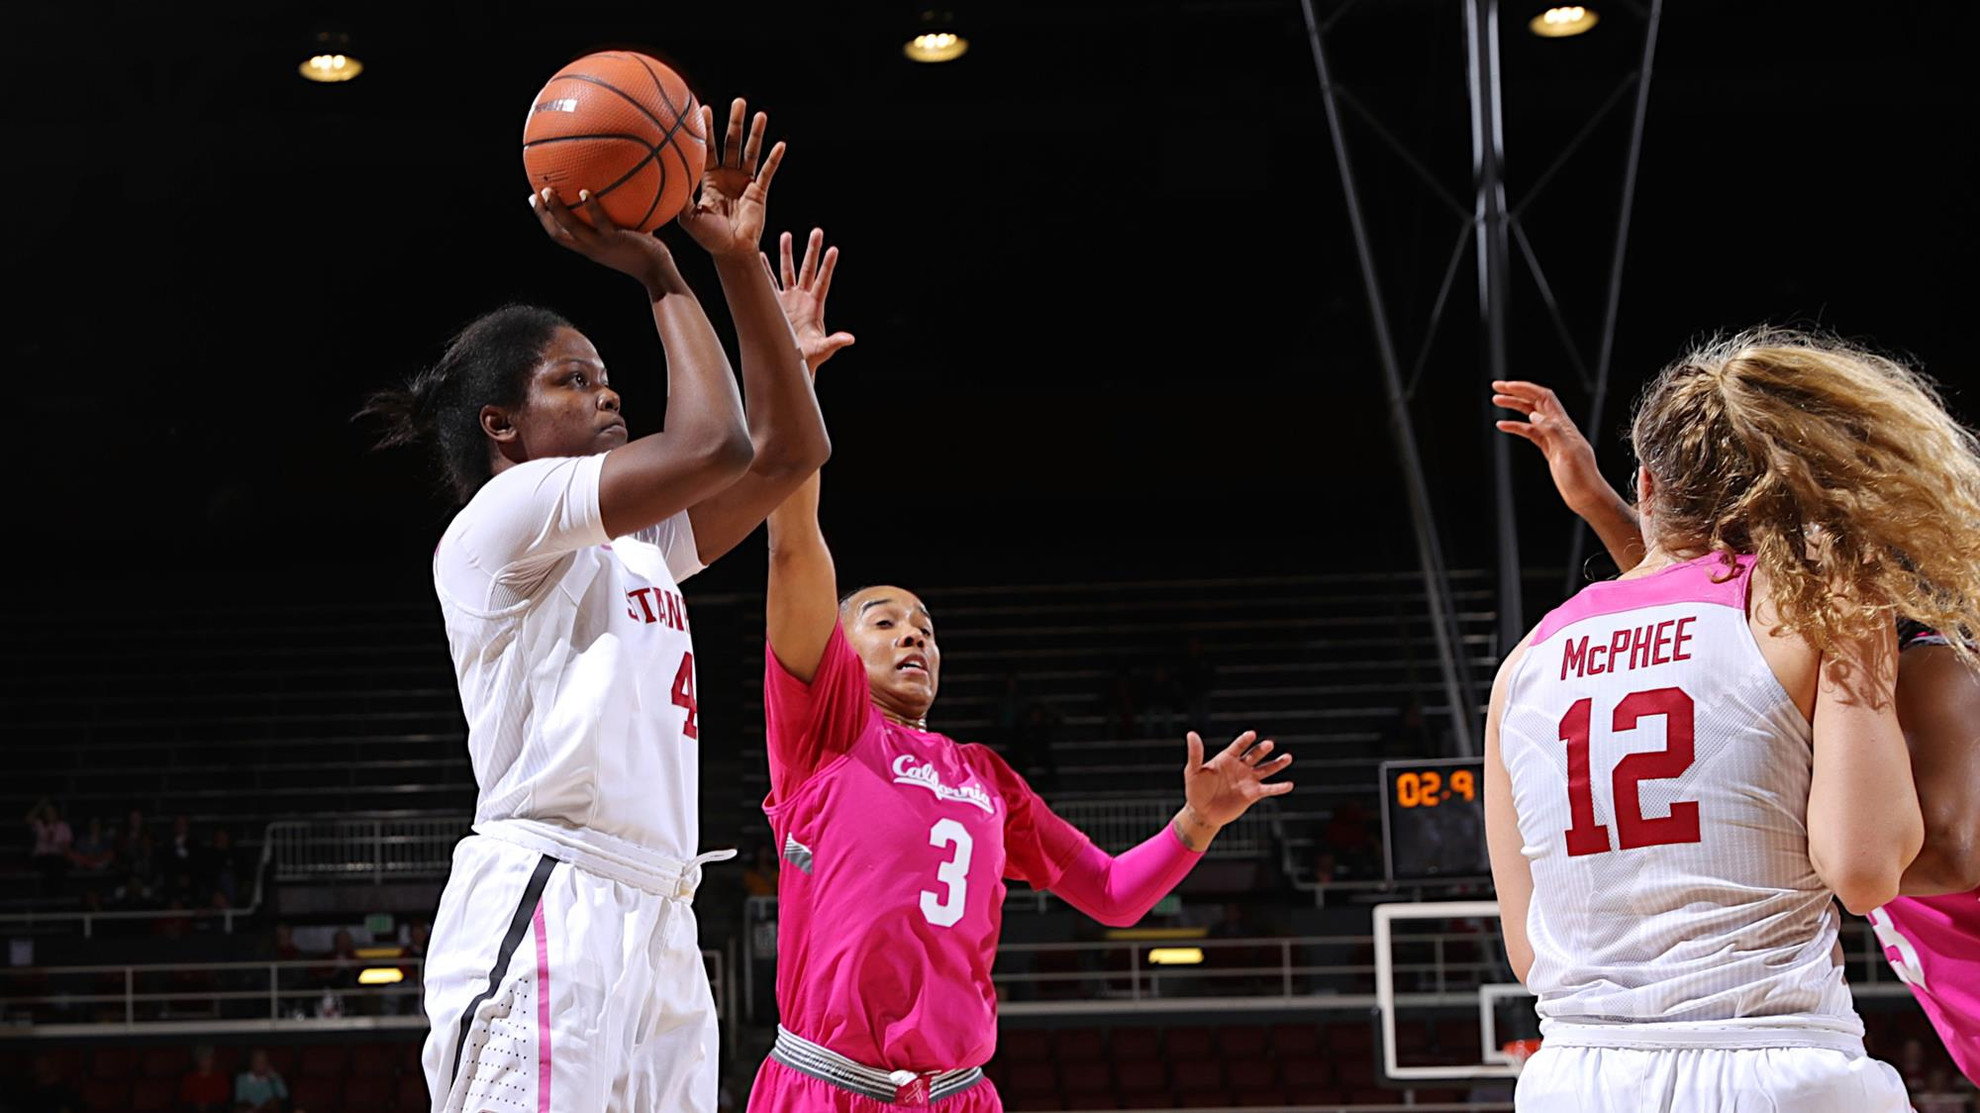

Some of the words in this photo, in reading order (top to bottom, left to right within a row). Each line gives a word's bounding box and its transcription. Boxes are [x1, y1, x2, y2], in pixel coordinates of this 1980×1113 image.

[624, 586, 690, 634] STAN
[1560, 616, 1697, 681] McPHEE
[671, 651, 698, 740] 4
[892, 754, 995, 815] California
[1396, 769, 1476, 808] 02.9
[1559, 687, 1702, 857] 12
[919, 817, 973, 928] 3
